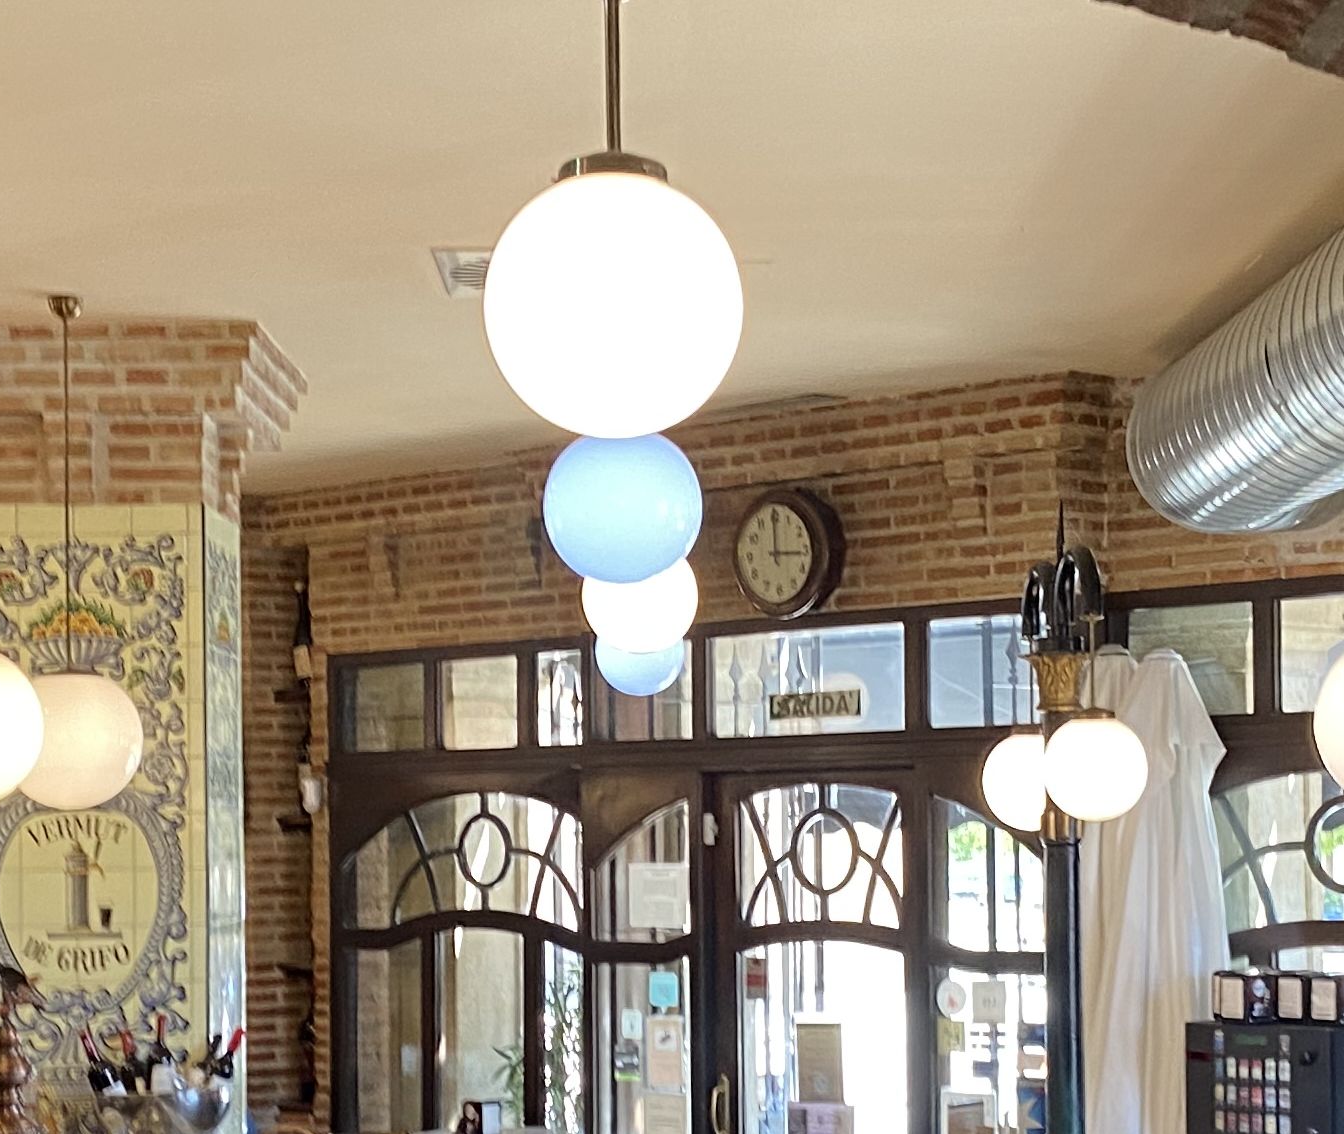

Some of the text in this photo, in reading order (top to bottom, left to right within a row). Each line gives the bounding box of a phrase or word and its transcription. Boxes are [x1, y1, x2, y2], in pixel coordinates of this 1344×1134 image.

[26, 814, 128, 847] VERMUT
[23, 935, 131, 975] DE GRIFO
